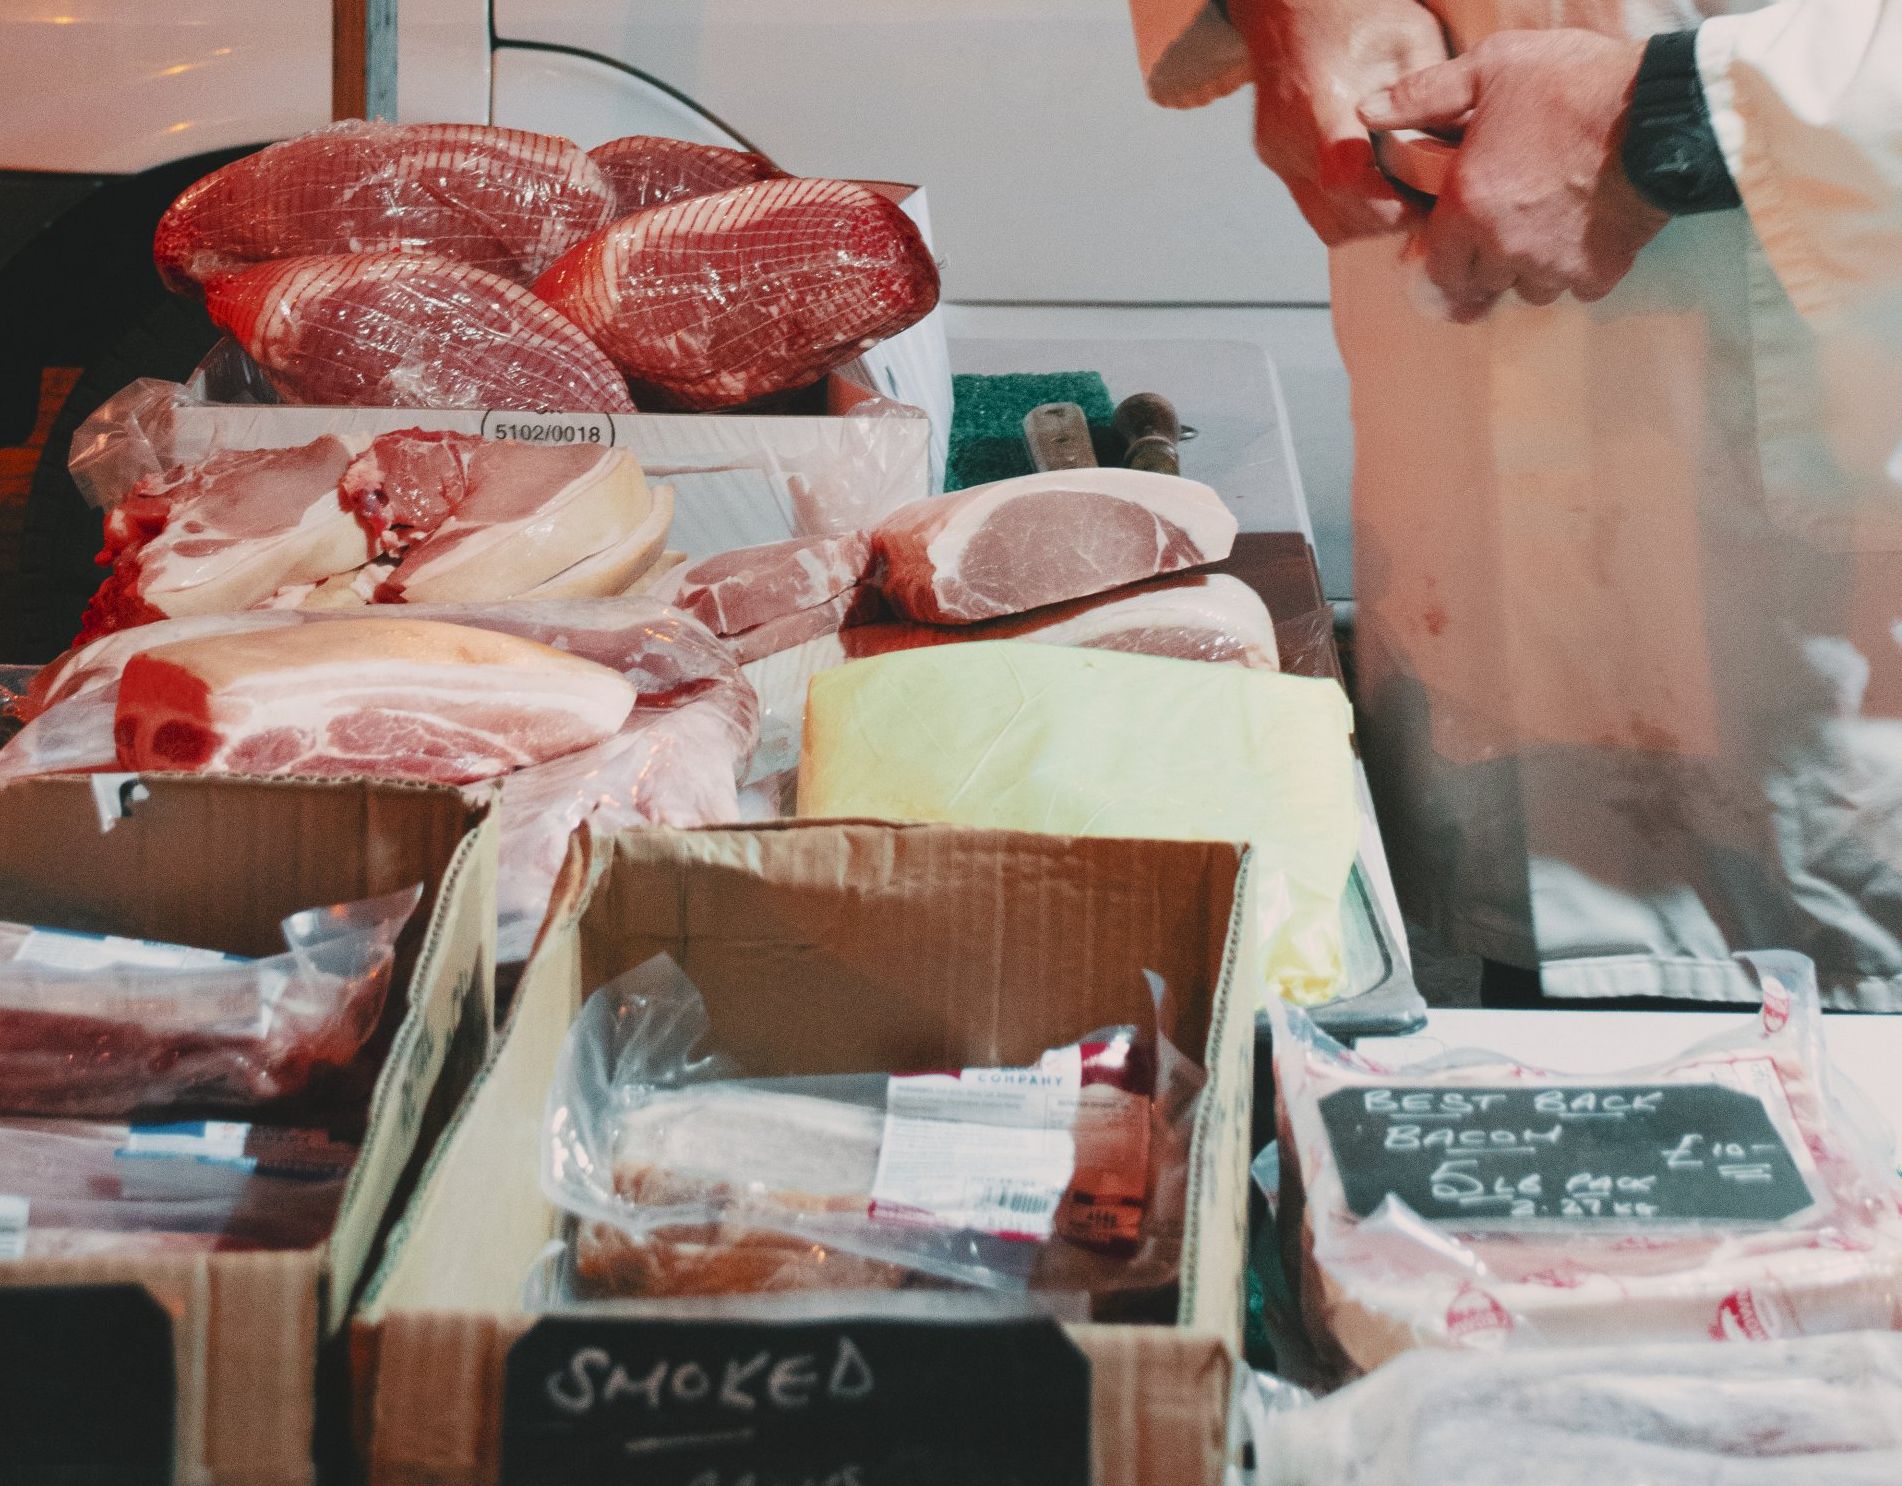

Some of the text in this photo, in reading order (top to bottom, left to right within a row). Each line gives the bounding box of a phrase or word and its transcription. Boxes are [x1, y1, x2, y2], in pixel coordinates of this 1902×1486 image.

[495, 424, 601, 443] 5102/0018
[977, 1074, 1063, 1087] COMPANY
[1364, 1089, 1664, 1113] BEST BACK
[1384, 1124, 1563, 1149] BACON
[1565, 1172, 1657, 1192] PACK
[545, 1337, 874, 1413] SMOKED
